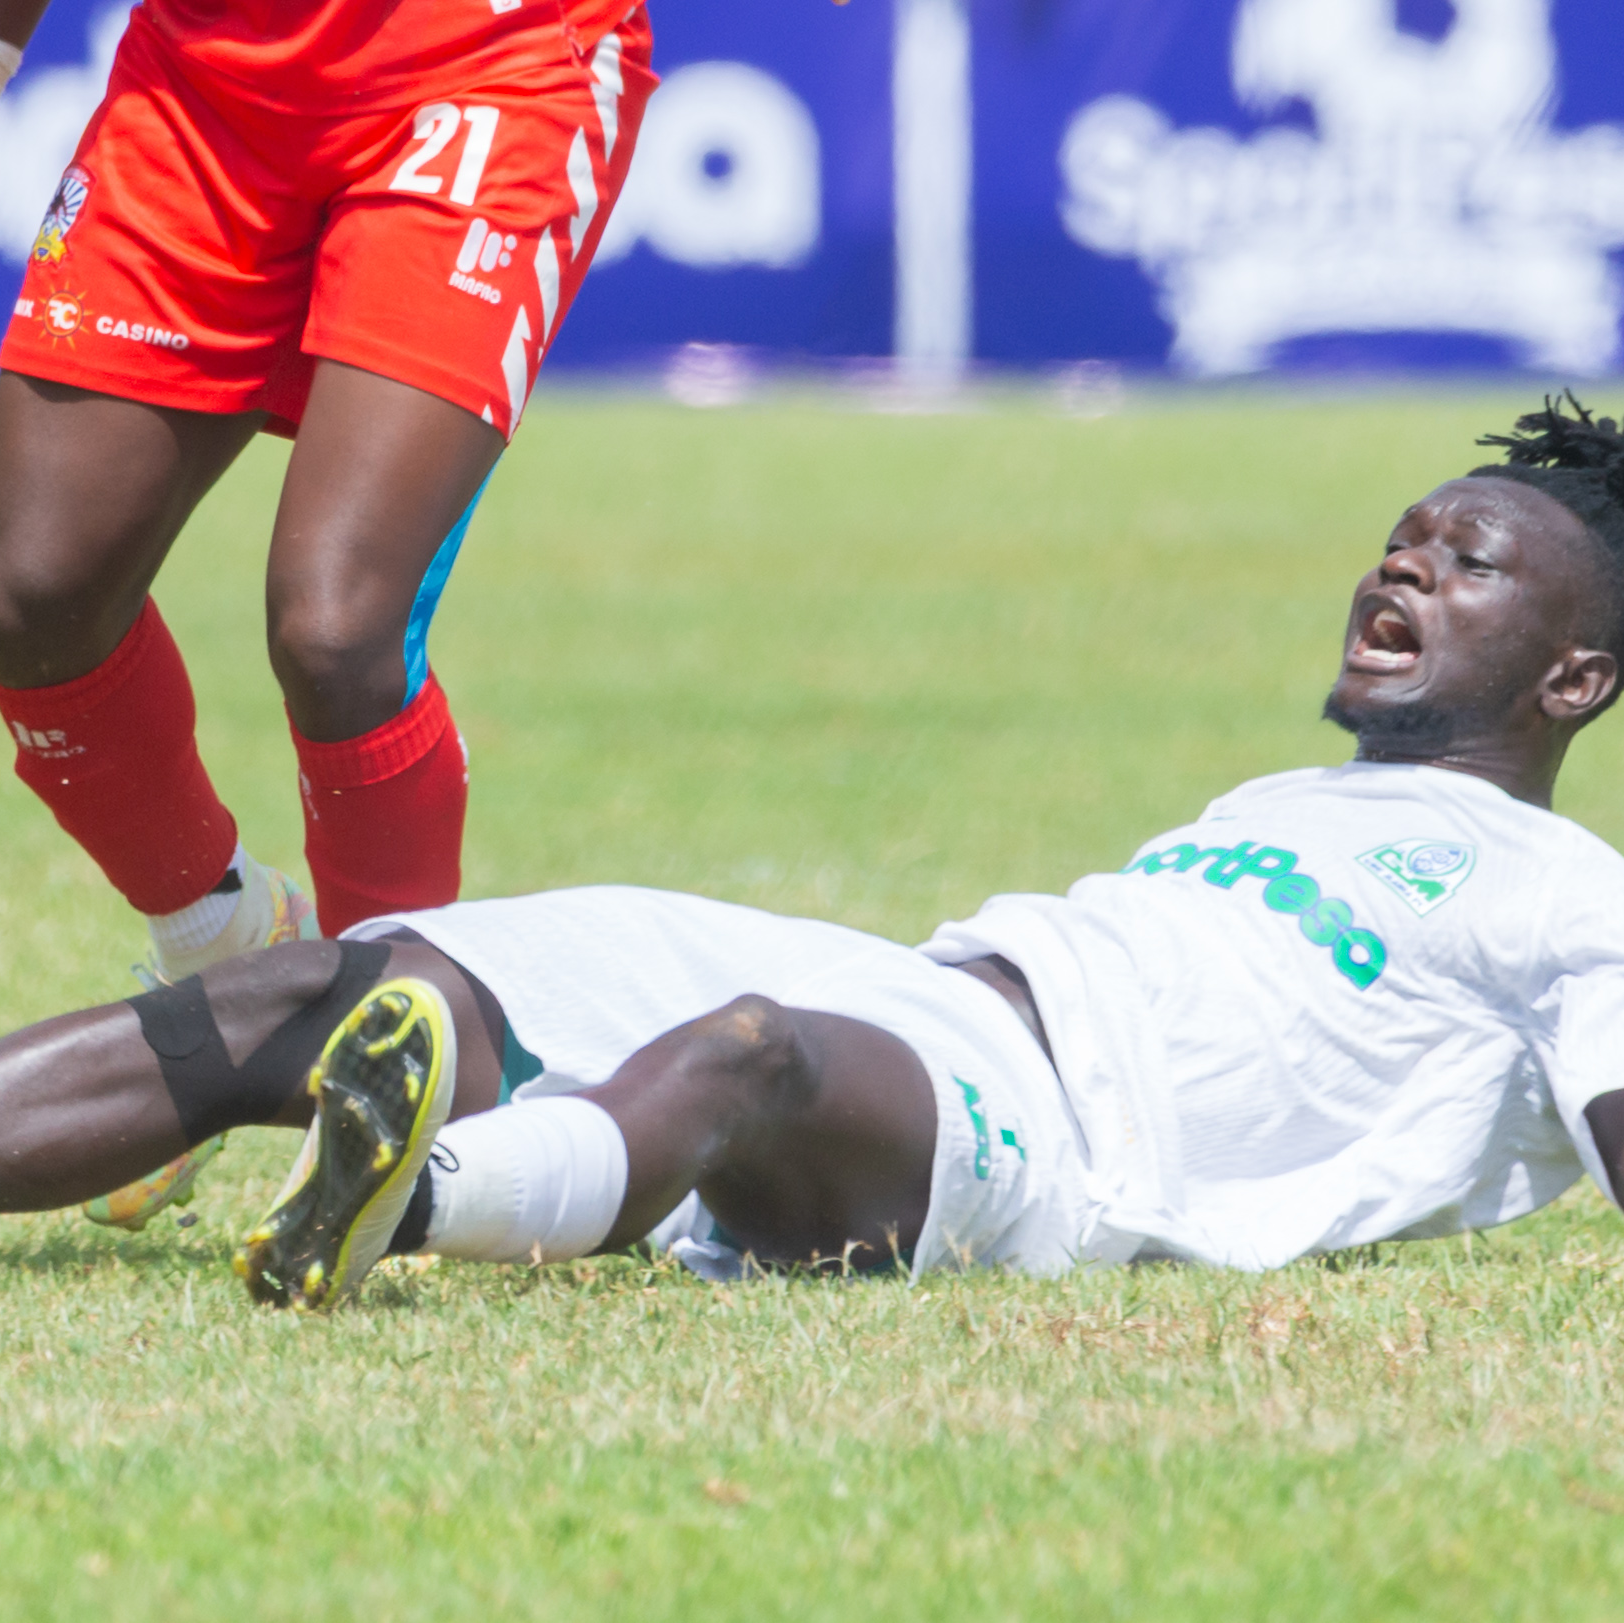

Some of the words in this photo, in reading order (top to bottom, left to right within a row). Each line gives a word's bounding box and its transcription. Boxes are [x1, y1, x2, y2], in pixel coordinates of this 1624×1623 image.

[387, 101, 501, 207] 21
[95, 315, 190, 351] CASINO
[1116, 840, 1388, 992] ortPesa
